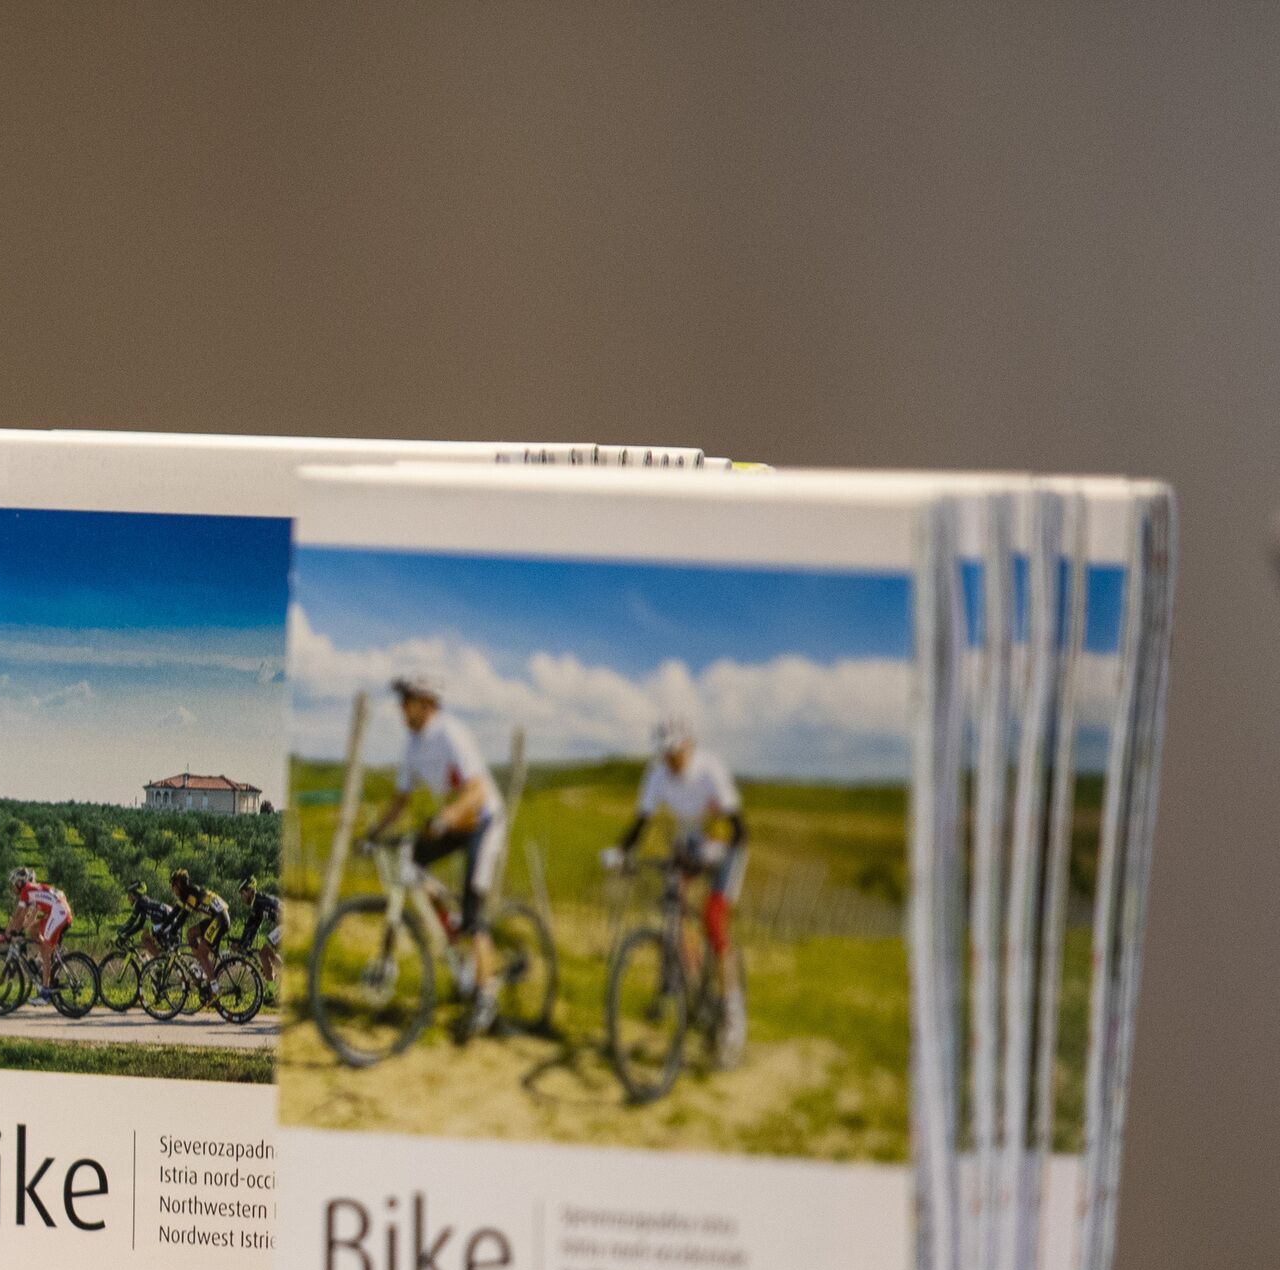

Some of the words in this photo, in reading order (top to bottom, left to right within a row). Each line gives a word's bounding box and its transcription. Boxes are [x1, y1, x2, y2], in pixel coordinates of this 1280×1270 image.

[159, 1165, 198, 1186] Istria
[159, 1195, 268, 1219] Northwestern
[159, 1225, 235, 1247] Nordwest
